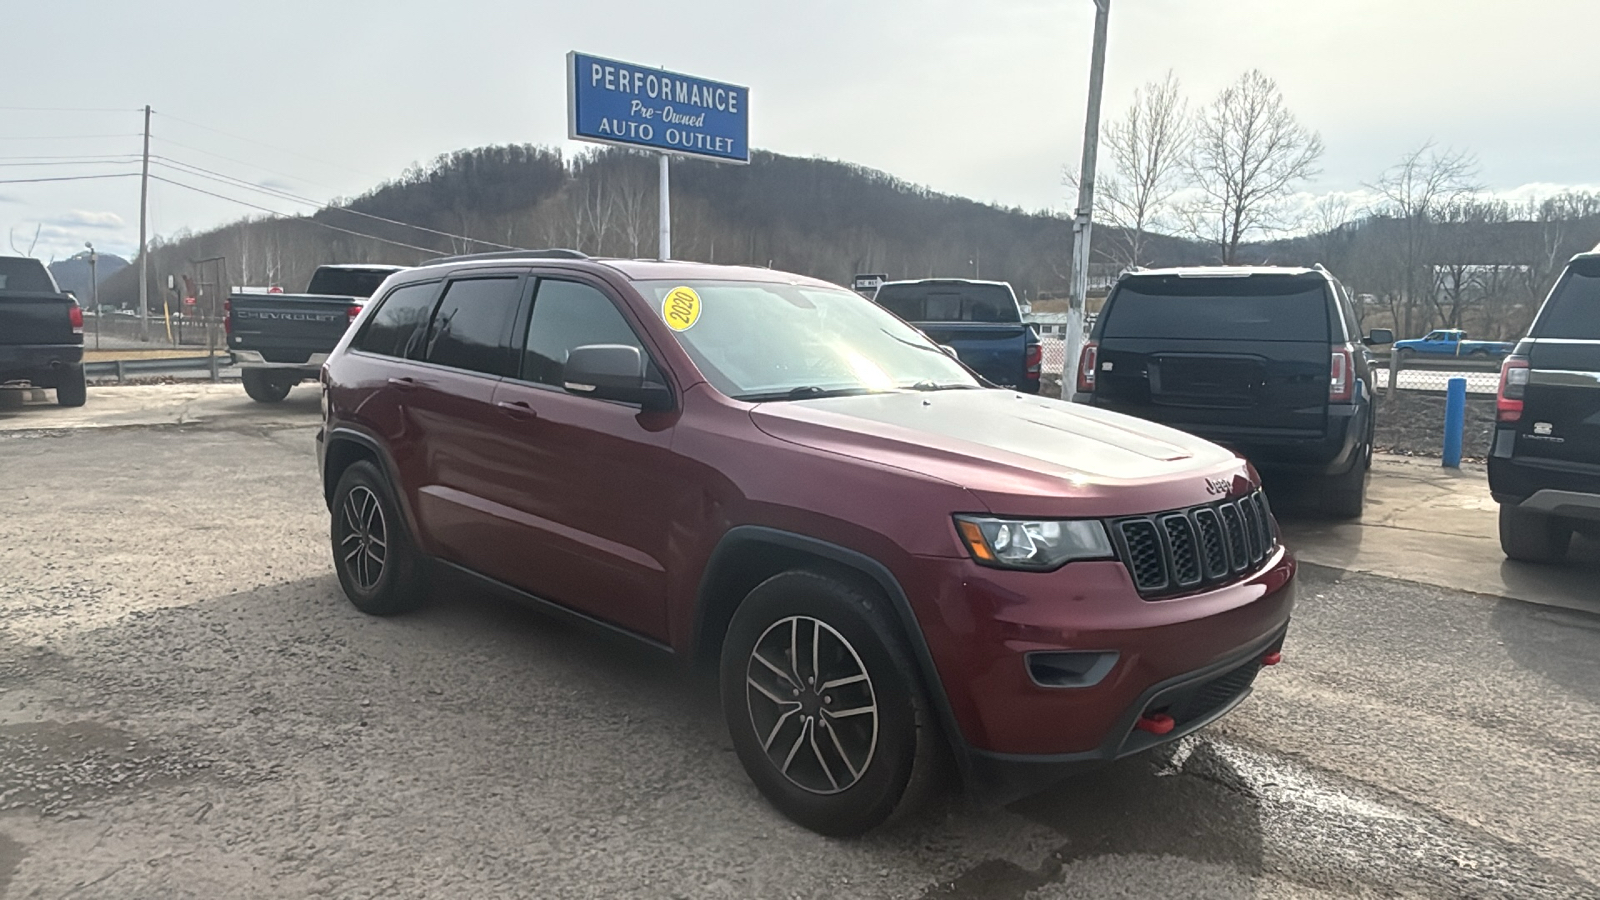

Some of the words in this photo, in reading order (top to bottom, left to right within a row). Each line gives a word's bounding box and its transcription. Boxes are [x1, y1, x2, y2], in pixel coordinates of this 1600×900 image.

[591, 63, 738, 114] PERFORMANCE
[630, 100, 706, 128] Pre-Owned
[598, 117, 654, 141] AUTO
[665, 128, 734, 153] OUTLET
[237, 311, 338, 322] CHEVROLET
[669, 291, 695, 324] 2020
[1204, 477, 1231, 496] Jeep
